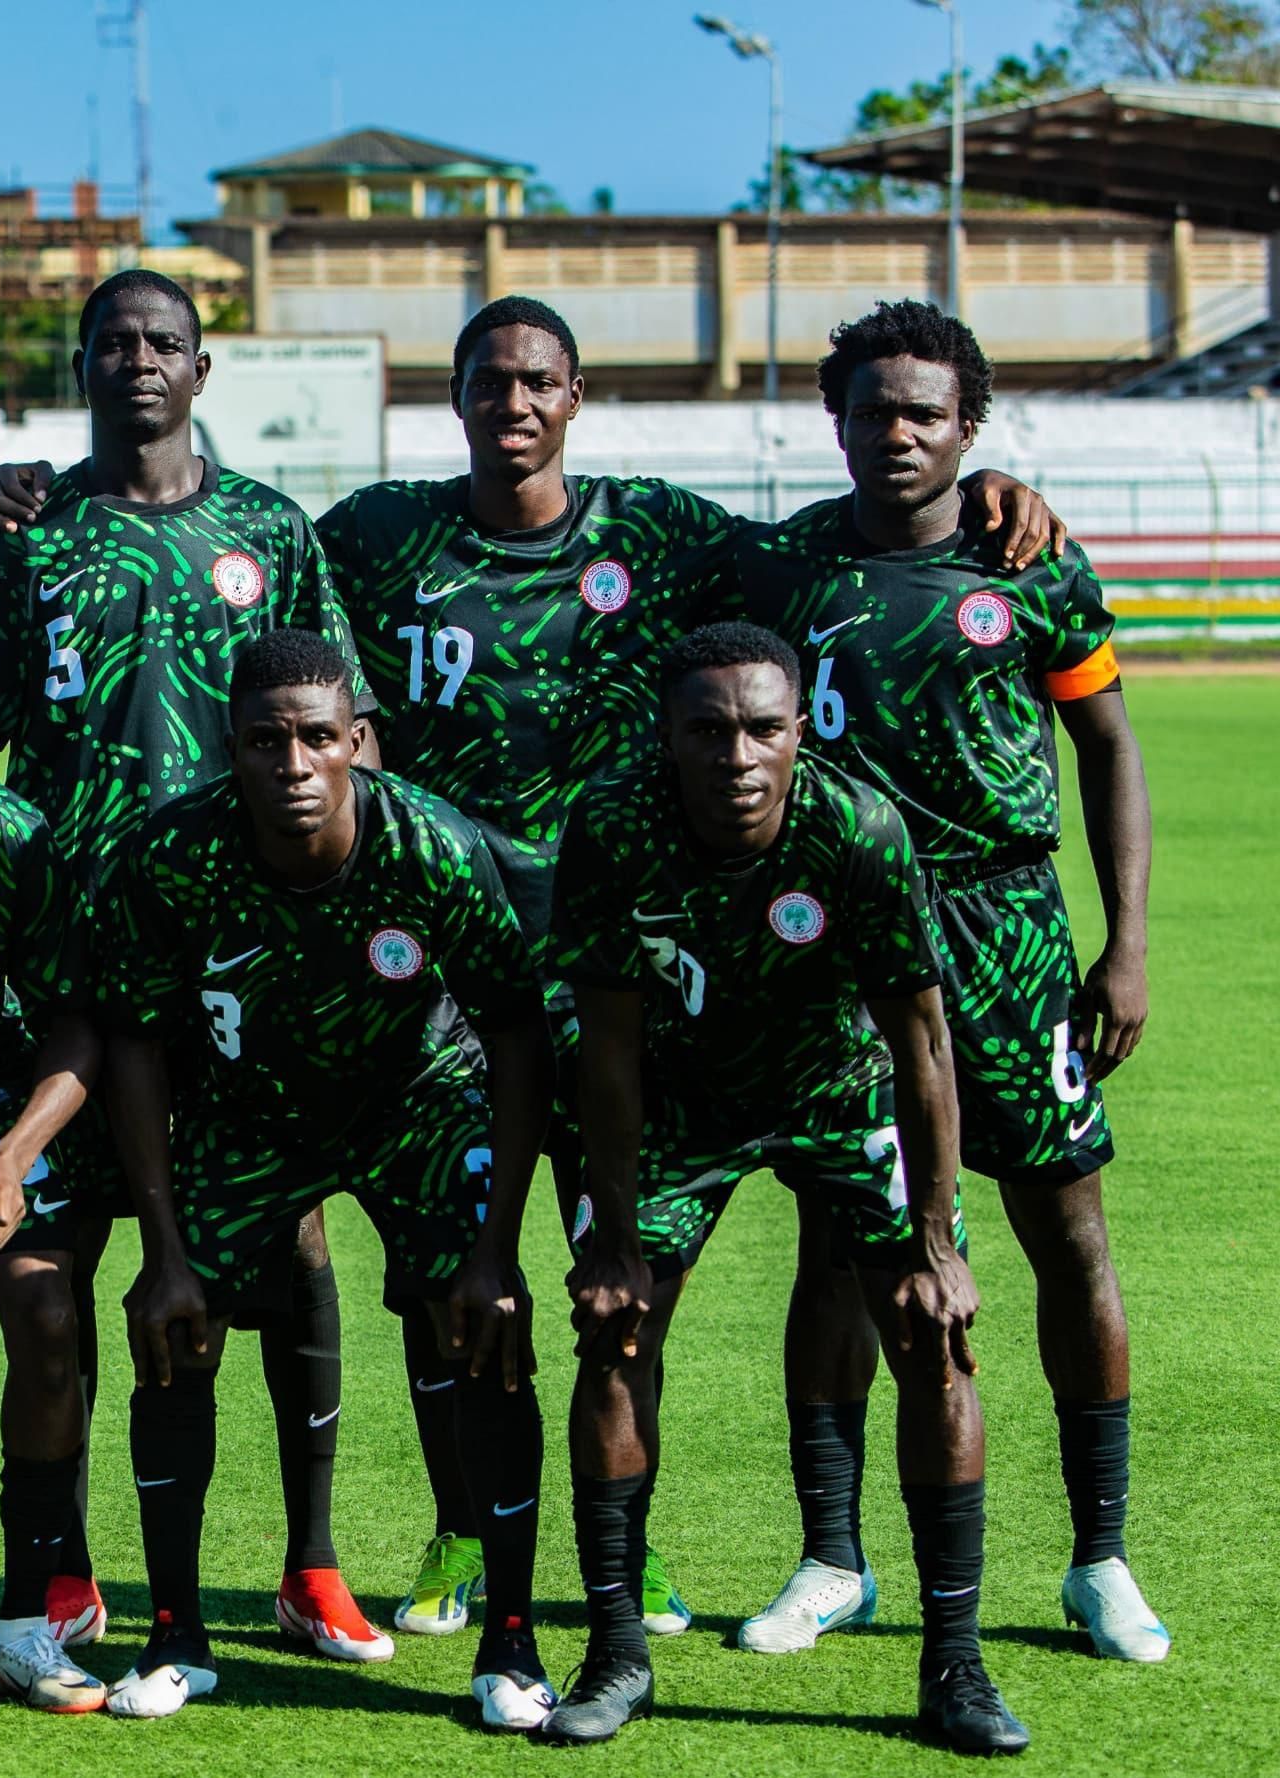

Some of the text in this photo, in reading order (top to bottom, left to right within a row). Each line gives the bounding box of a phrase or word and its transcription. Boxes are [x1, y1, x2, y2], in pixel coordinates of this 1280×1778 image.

[45, 614, 86, 701] 5
[397, 625, 474, 705] 19
[812, 657, 845, 740] 6
[201, 990, 241, 1060] 3
[1051, 1019, 1086, 1103] 6
